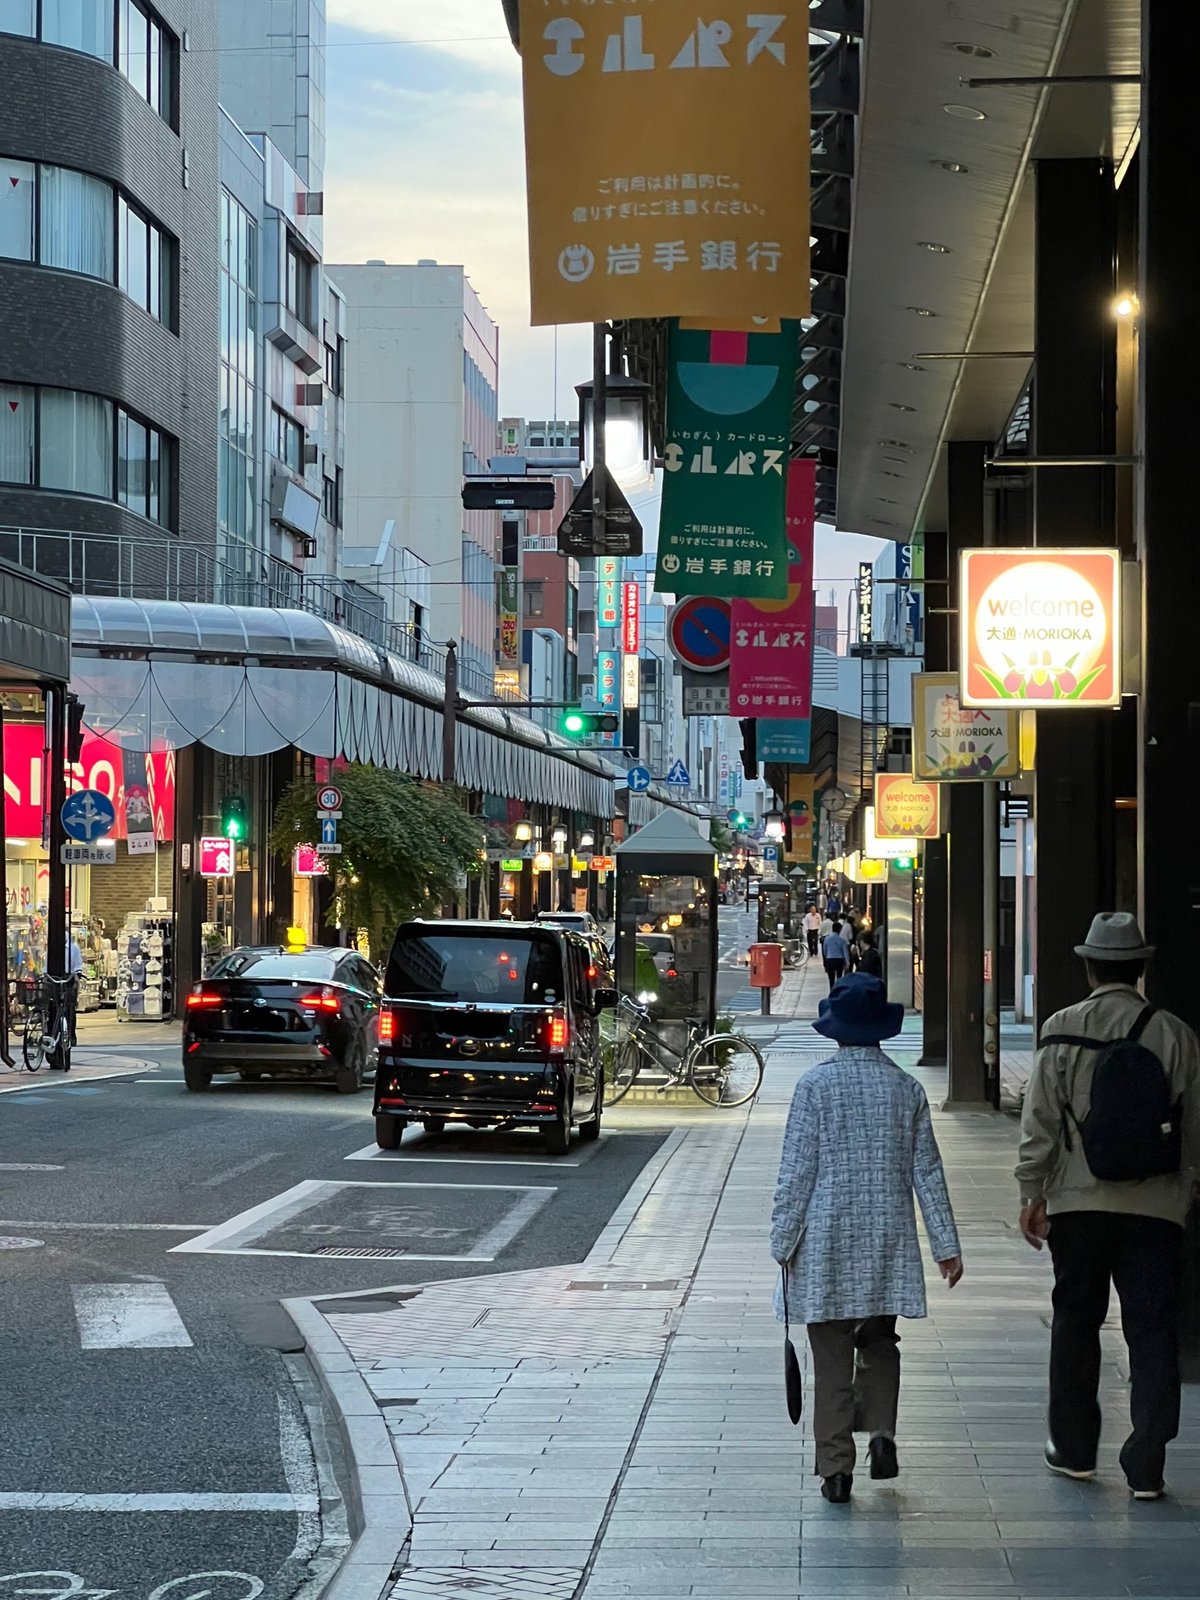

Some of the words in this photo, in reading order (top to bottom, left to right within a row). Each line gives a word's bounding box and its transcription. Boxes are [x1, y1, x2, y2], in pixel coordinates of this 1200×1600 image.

[597, 173, 740, 193] ご利用は計画的に。
[572, 200, 767, 223] 借りすぎにご注意ください。
[606, 240, 782, 275] 岩手銀行
[684, 524, 755, 535] ご利用は計画的に。
[685, 557, 775, 576] 岩手銀行
[988, 593, 1095, 618] welcome
[323, 793, 337, 805] 30
[886, 791, 930, 803] welcome
[65, 848, 112, 860] 軽車両を除く
[766, 847, 776, 860] P
